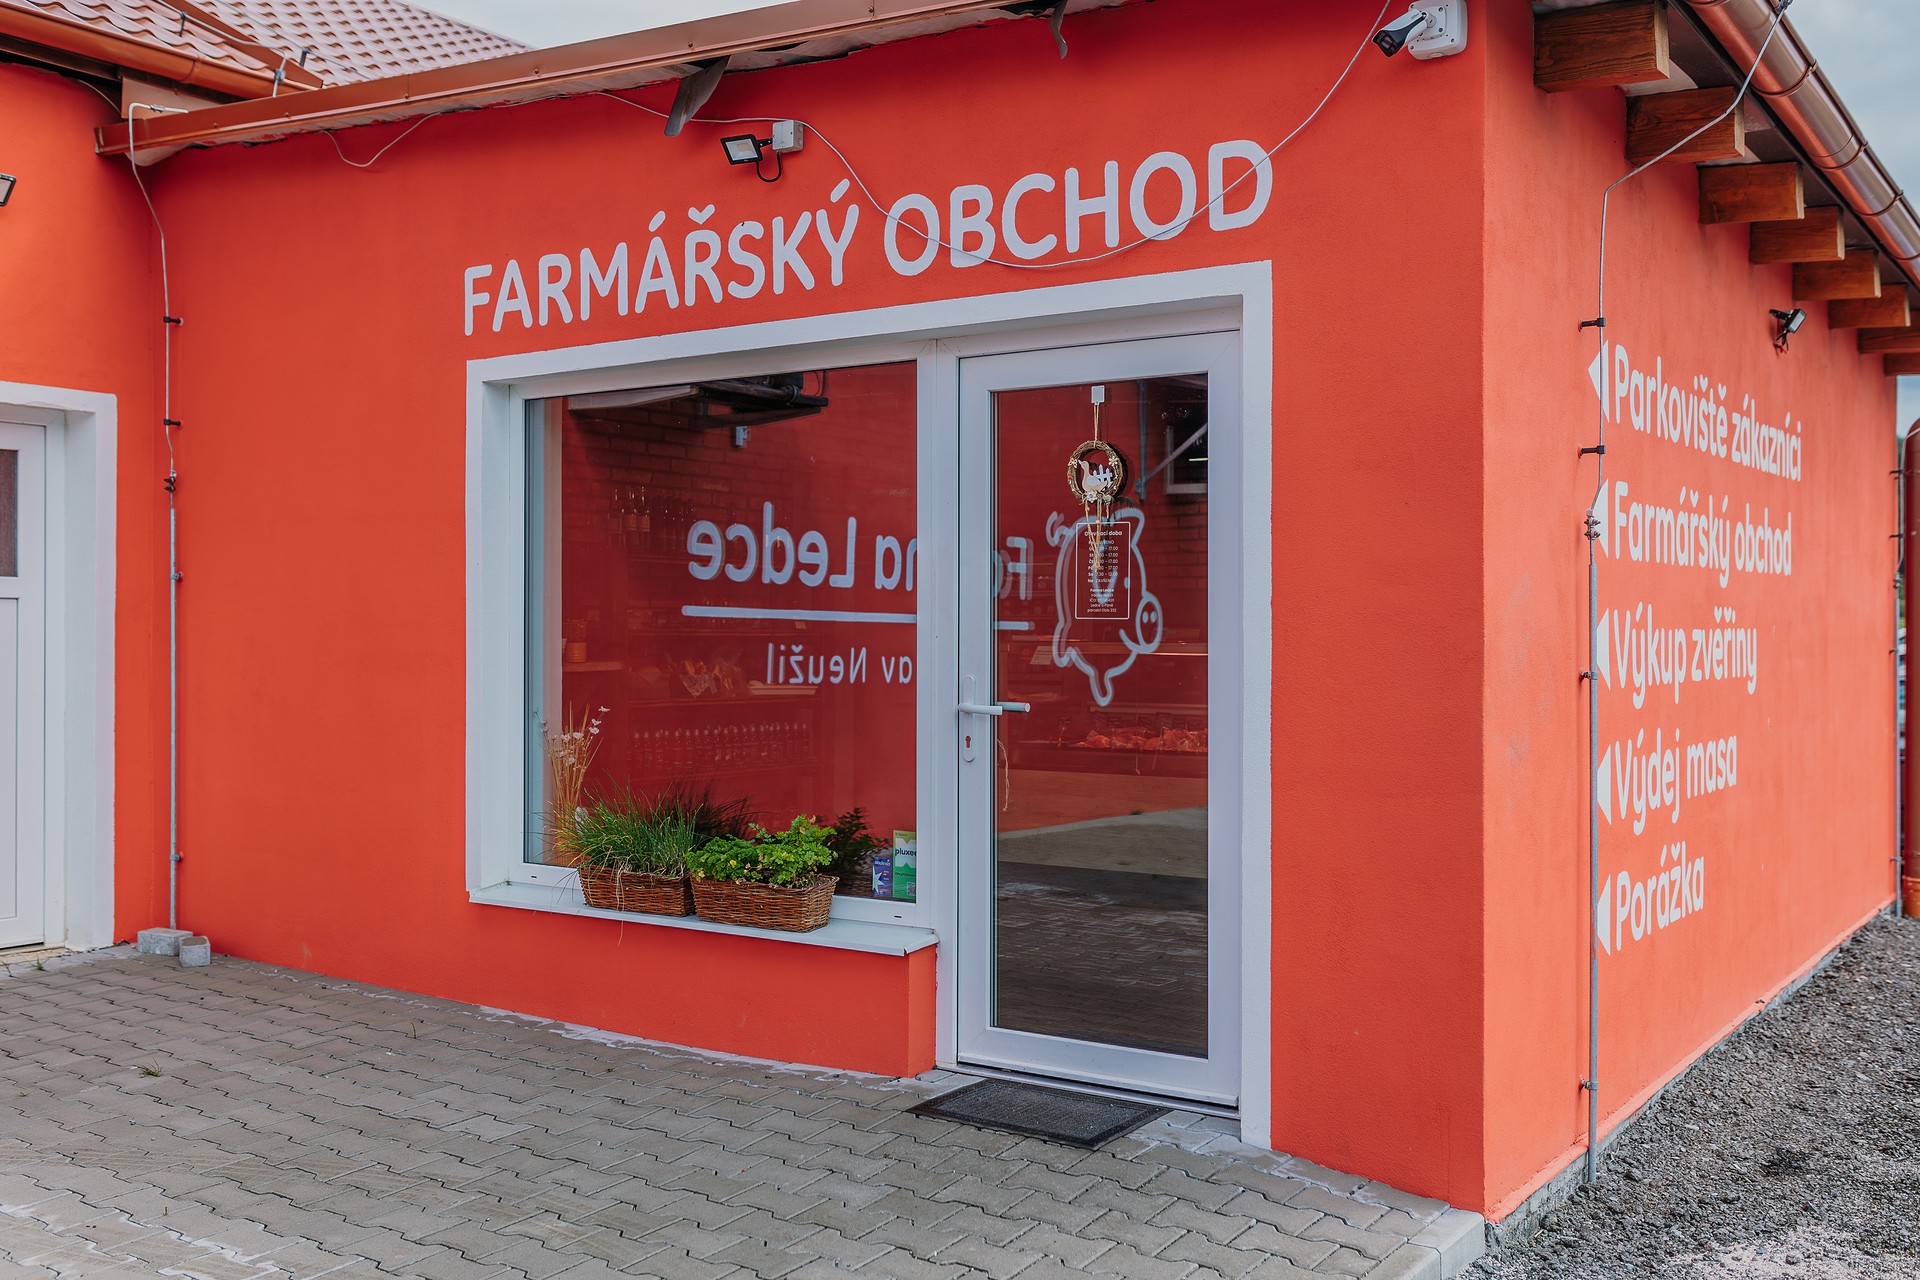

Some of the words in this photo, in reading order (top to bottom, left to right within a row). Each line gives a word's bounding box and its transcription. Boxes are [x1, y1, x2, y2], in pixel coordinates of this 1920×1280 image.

[463, 178, 860, 336] FARMÁŘSKÝ
[884, 139, 1274, 277] OBCHOD
[1614, 344, 1728, 459] Parkoviště
[1731, 393, 1802, 482] zákazníci
[1614, 481, 1730, 589] Farmářský
[1734, 502, 1792, 576] obchod
[1614, 601, 1687, 710] Výkup
[1691, 606, 1757, 695] zvěřiny
[1615, 727, 1681, 836] Výdej
[1686, 735, 1737, 799] masa
[1616, 840, 1705, 952] Porážka
